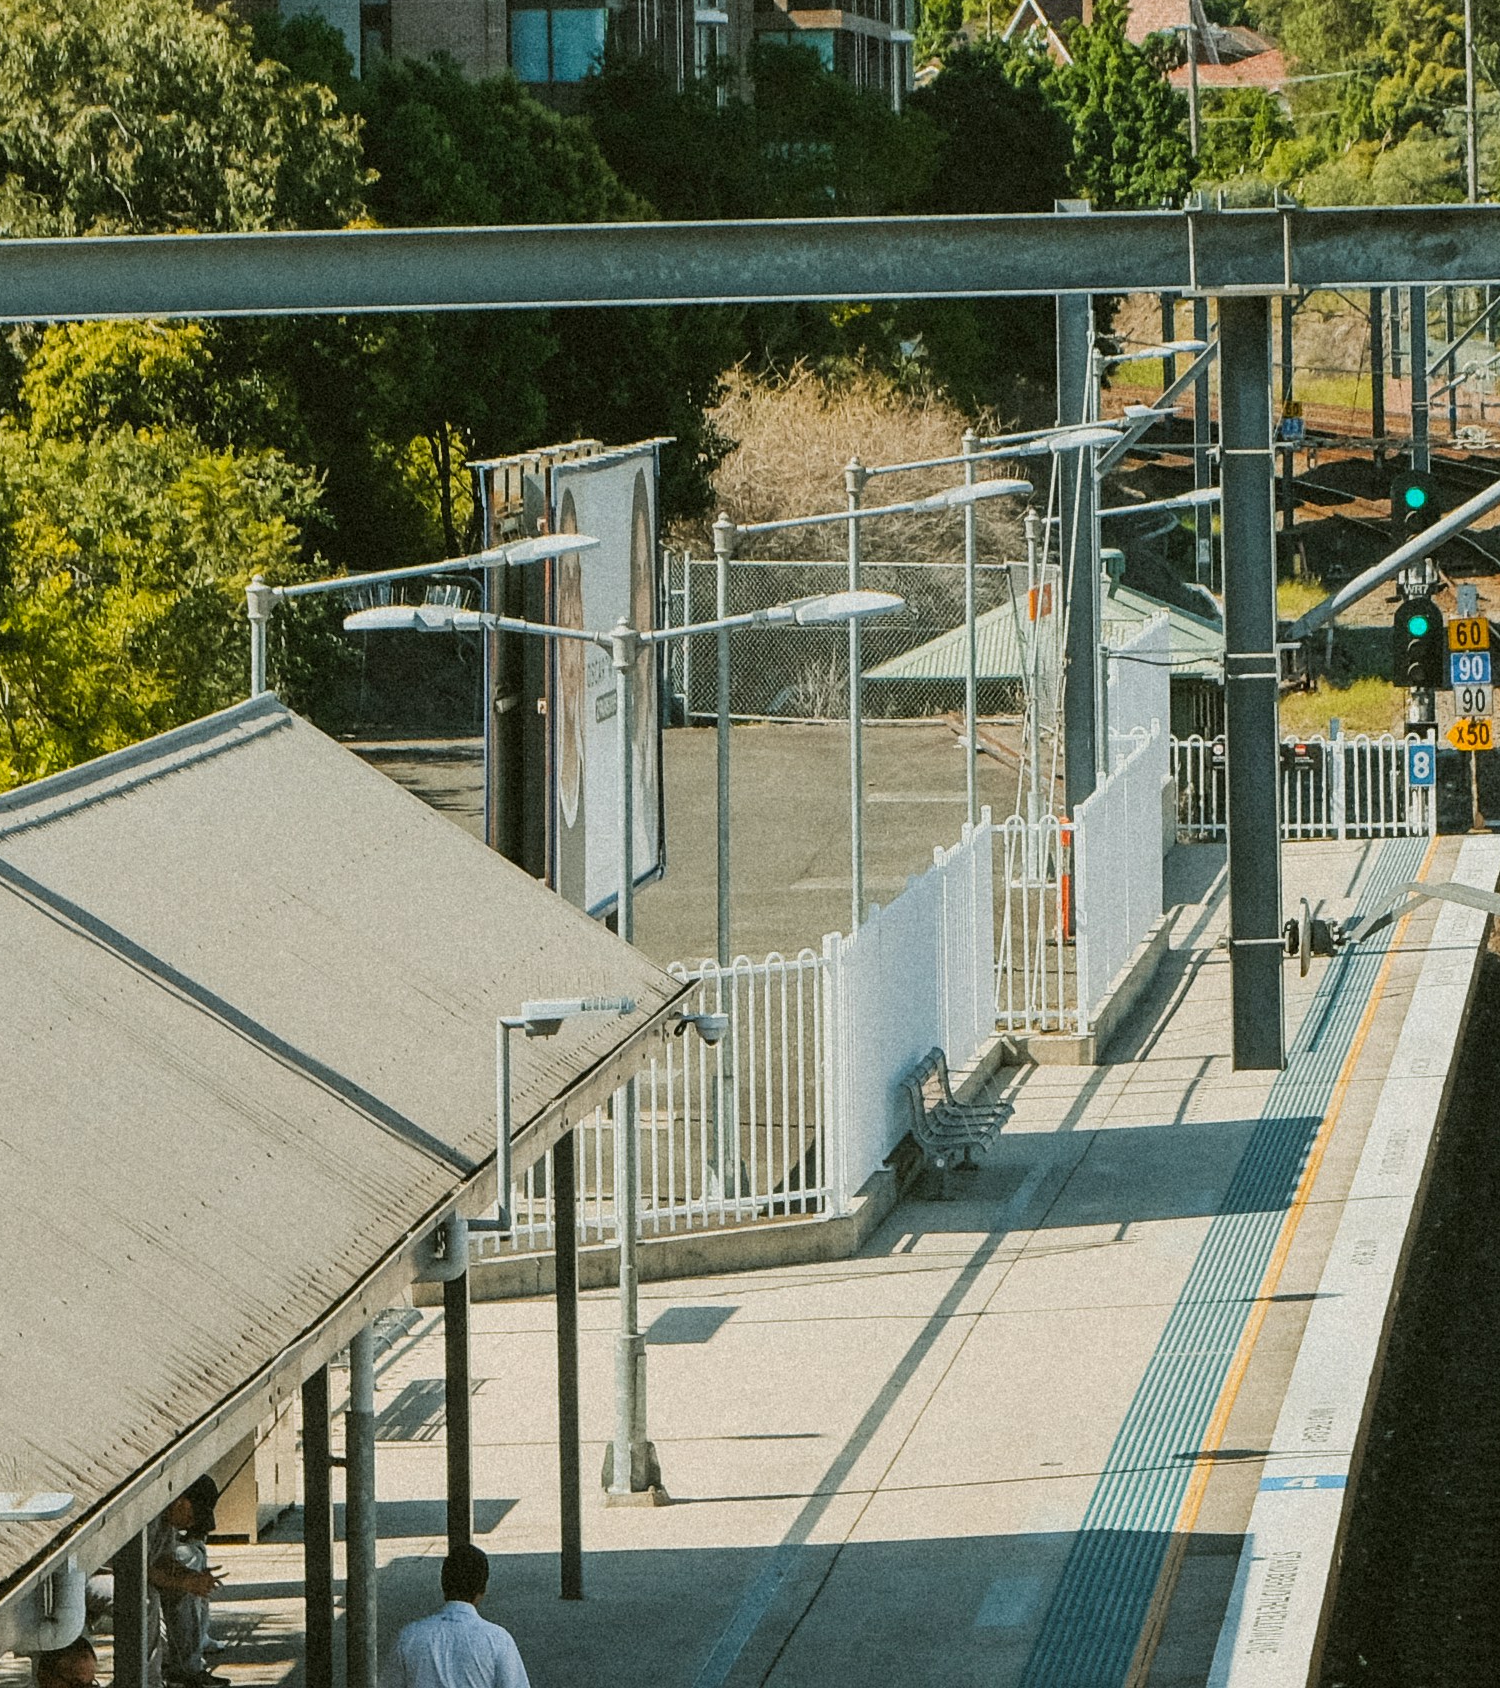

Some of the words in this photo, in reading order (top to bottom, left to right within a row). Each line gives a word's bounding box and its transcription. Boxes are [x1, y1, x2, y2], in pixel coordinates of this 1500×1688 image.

[1456, 620, 1482, 646] 60
[1459, 655, 1484, 681] 90
[1462, 687, 1486, 713] 90
[1412, 751, 1430, 779] 8
[1283, 1477, 1319, 1489] 4
